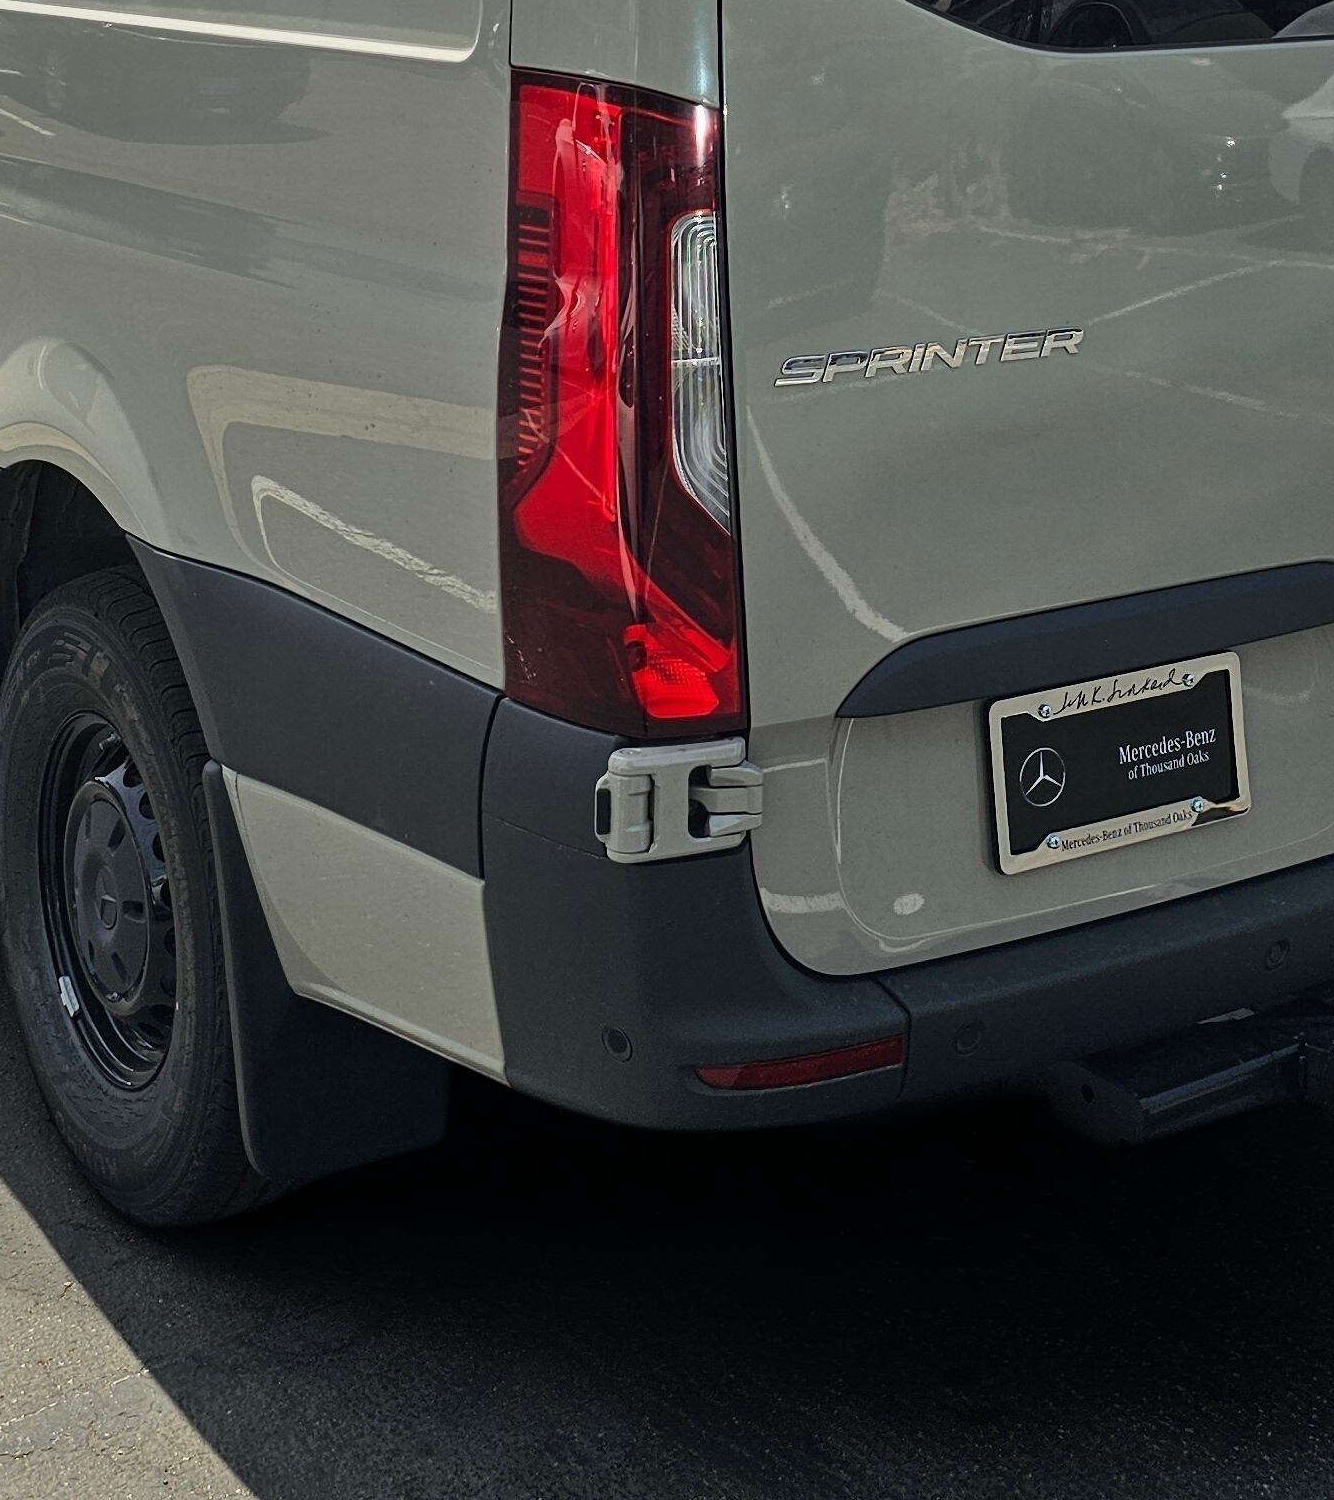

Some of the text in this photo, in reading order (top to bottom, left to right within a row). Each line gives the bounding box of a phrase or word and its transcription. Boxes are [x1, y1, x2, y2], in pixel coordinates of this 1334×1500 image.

[774, 326, 1084, 387] SPRINTER
[1119, 728, 1216, 765] Mercedes-Benz
[1128, 749, 1210, 780] of Thousand Oaks
[1061, 809, 1193, 851] Mercedes-Benz of Thousand Oaks
